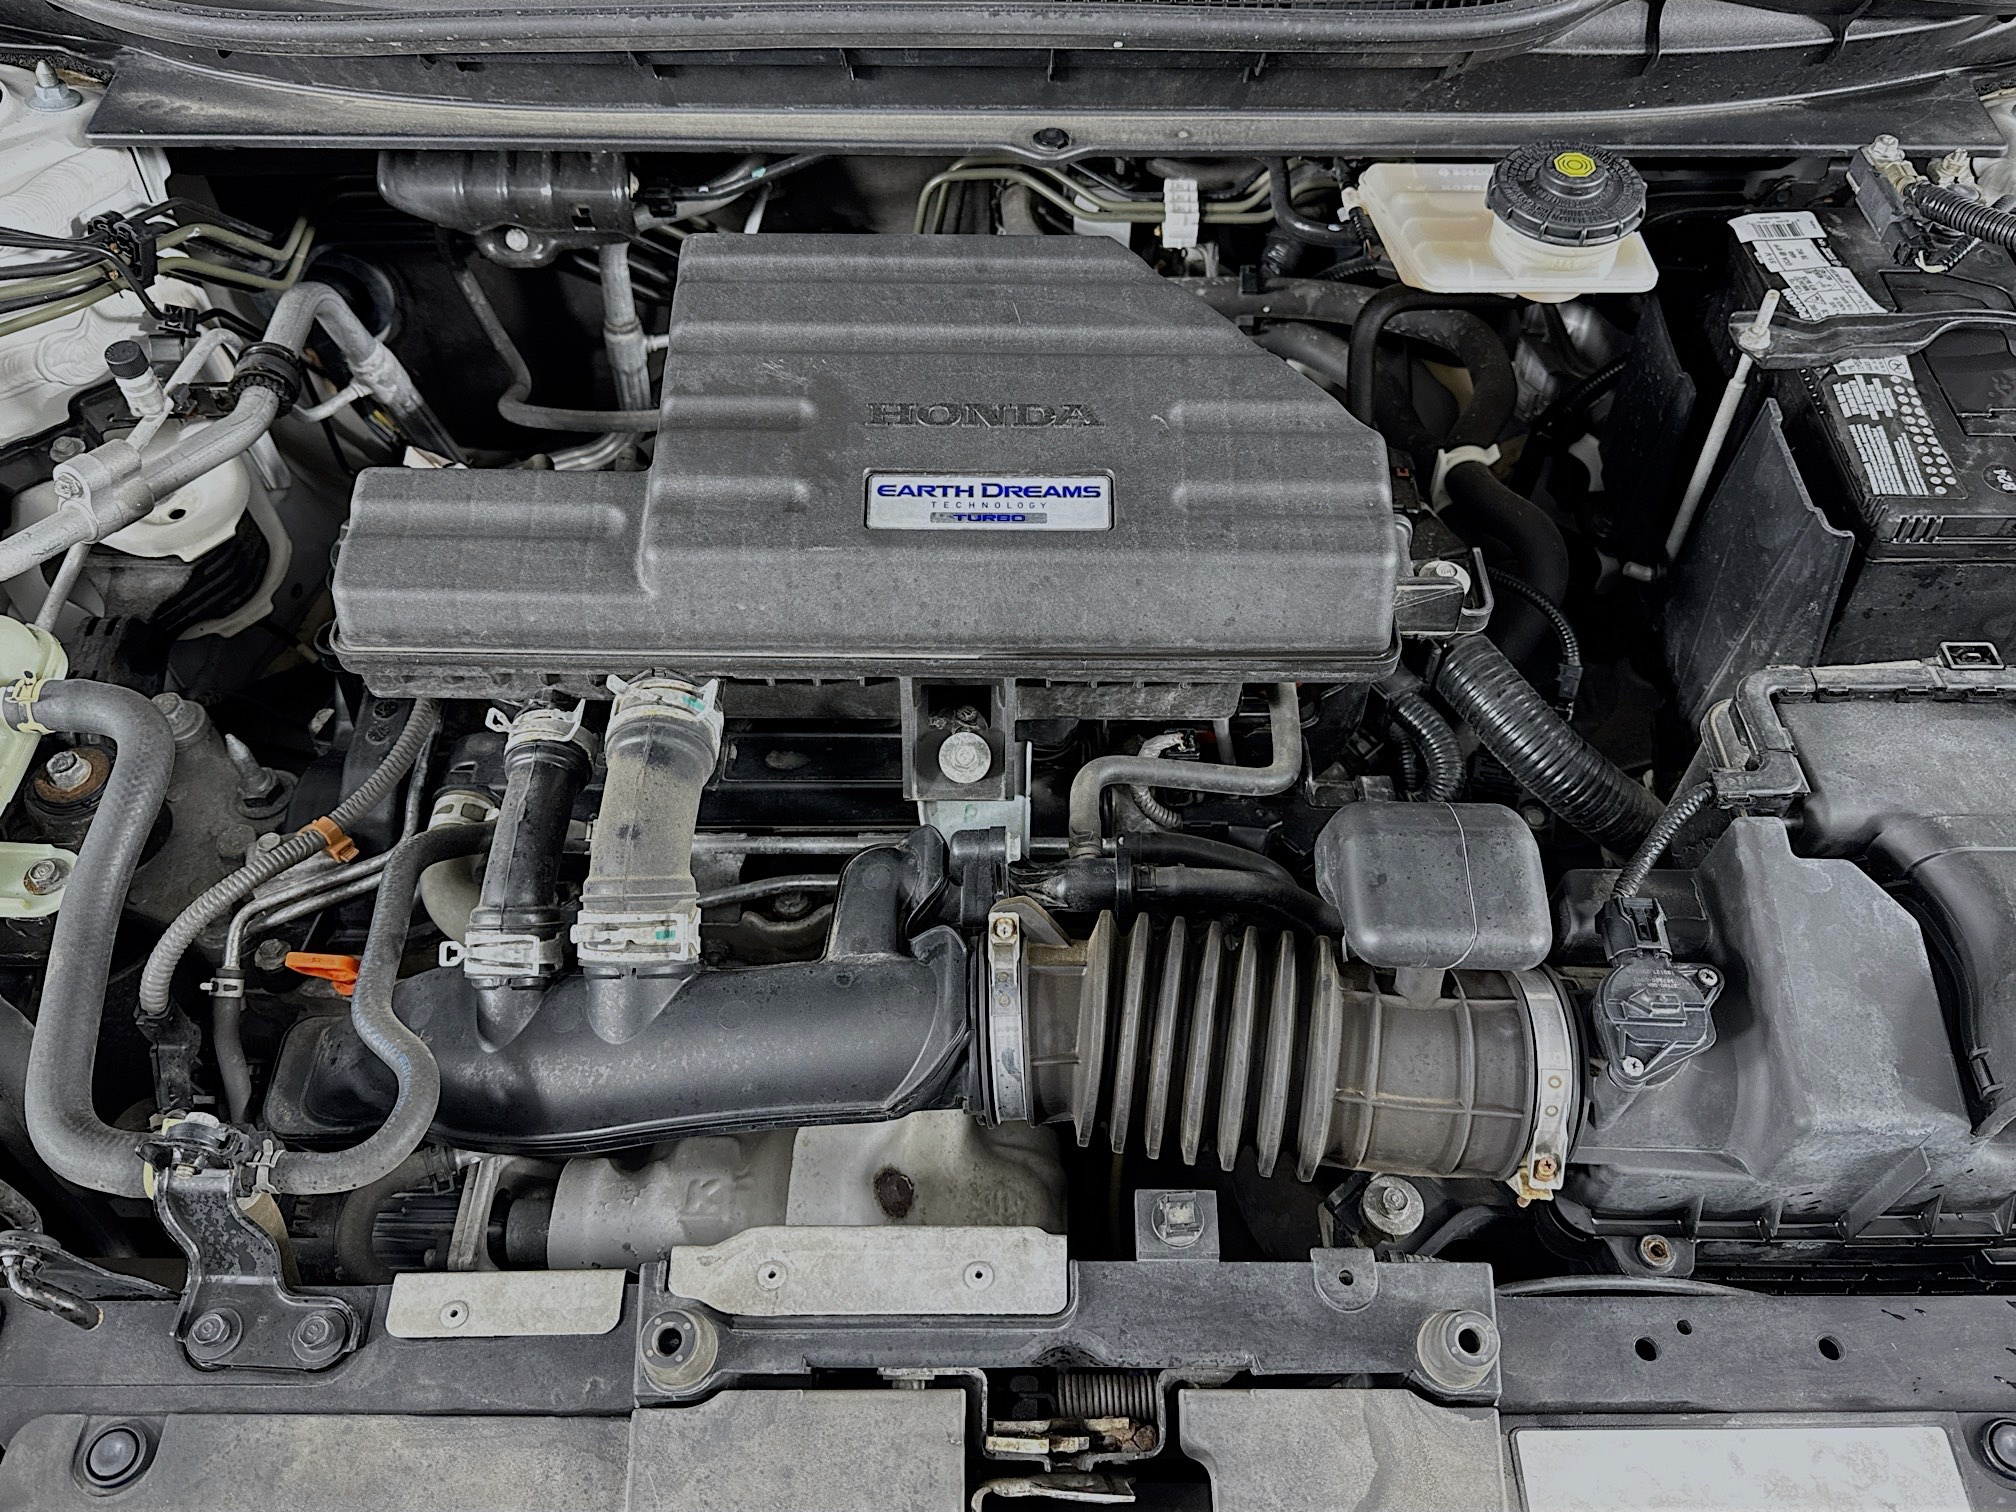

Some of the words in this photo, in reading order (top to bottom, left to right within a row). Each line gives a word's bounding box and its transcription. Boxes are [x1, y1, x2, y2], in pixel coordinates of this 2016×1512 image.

[865, 402, 1106, 428] HONDA
[877, 484, 974, 498] EARTH
[981, 482, 1101, 498] DREAMS
[931, 501, 1047, 509] TECHNOLOGY
[953, 513, 1026, 522] TURBO
